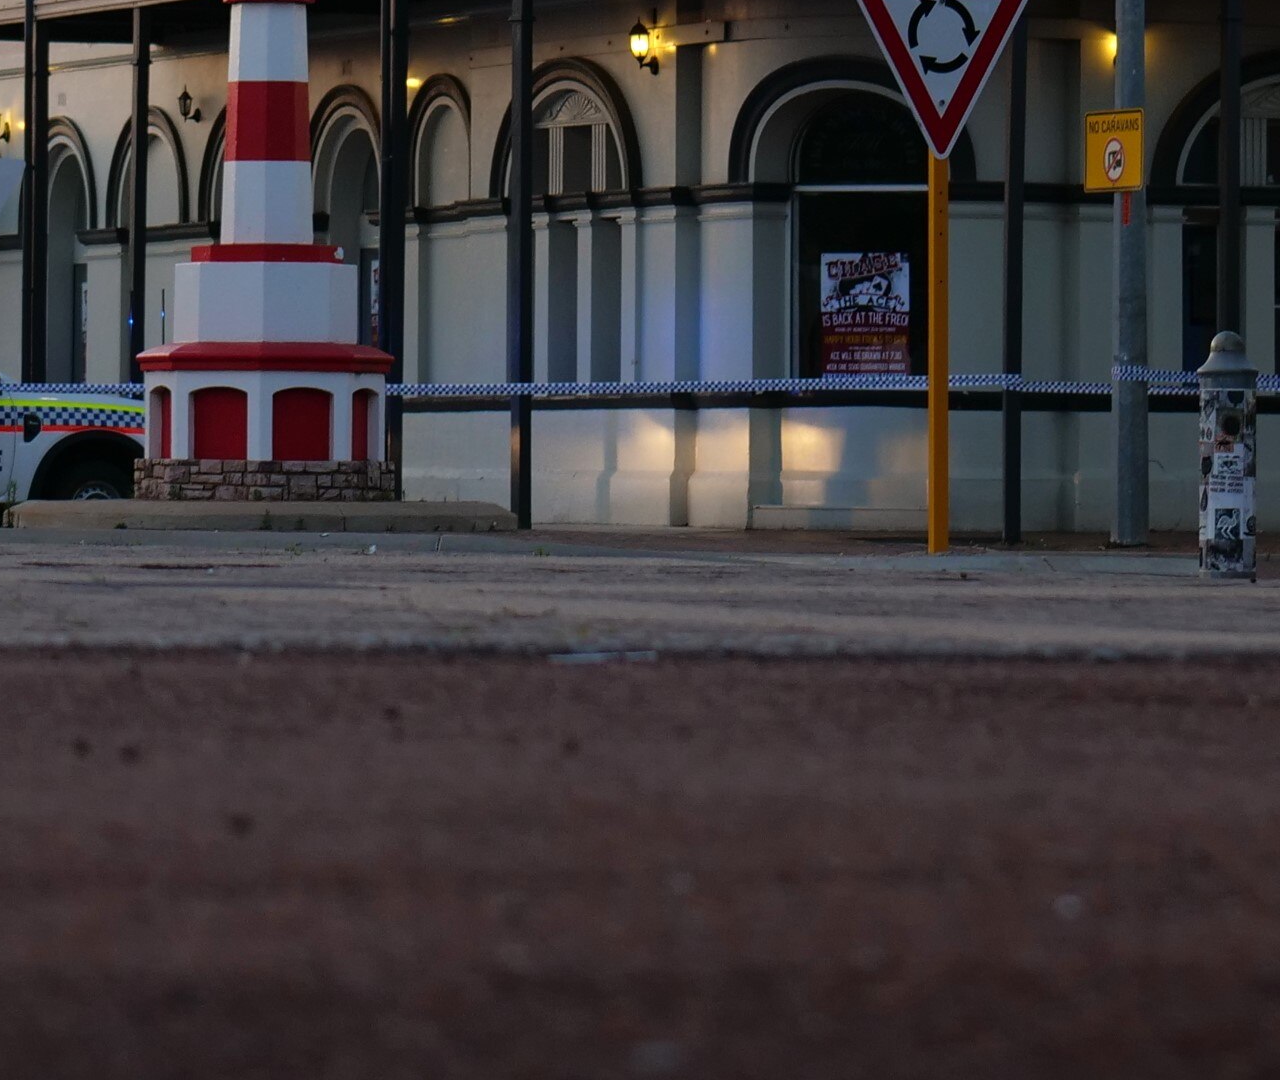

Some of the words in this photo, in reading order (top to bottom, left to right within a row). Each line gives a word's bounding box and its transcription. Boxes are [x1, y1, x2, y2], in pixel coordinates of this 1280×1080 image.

[1089, 121, 1100, 134] NO
[1101, 117, 1140, 133] CARAVANS
[826, 254, 899, 281] CHASE
[822, 314, 831, 328] IS
[832, 313, 853, 326] BACK
[854, 312, 866, 325] AT
[868, 312, 884, 324] THE
[830, 351, 840, 360] ACE
